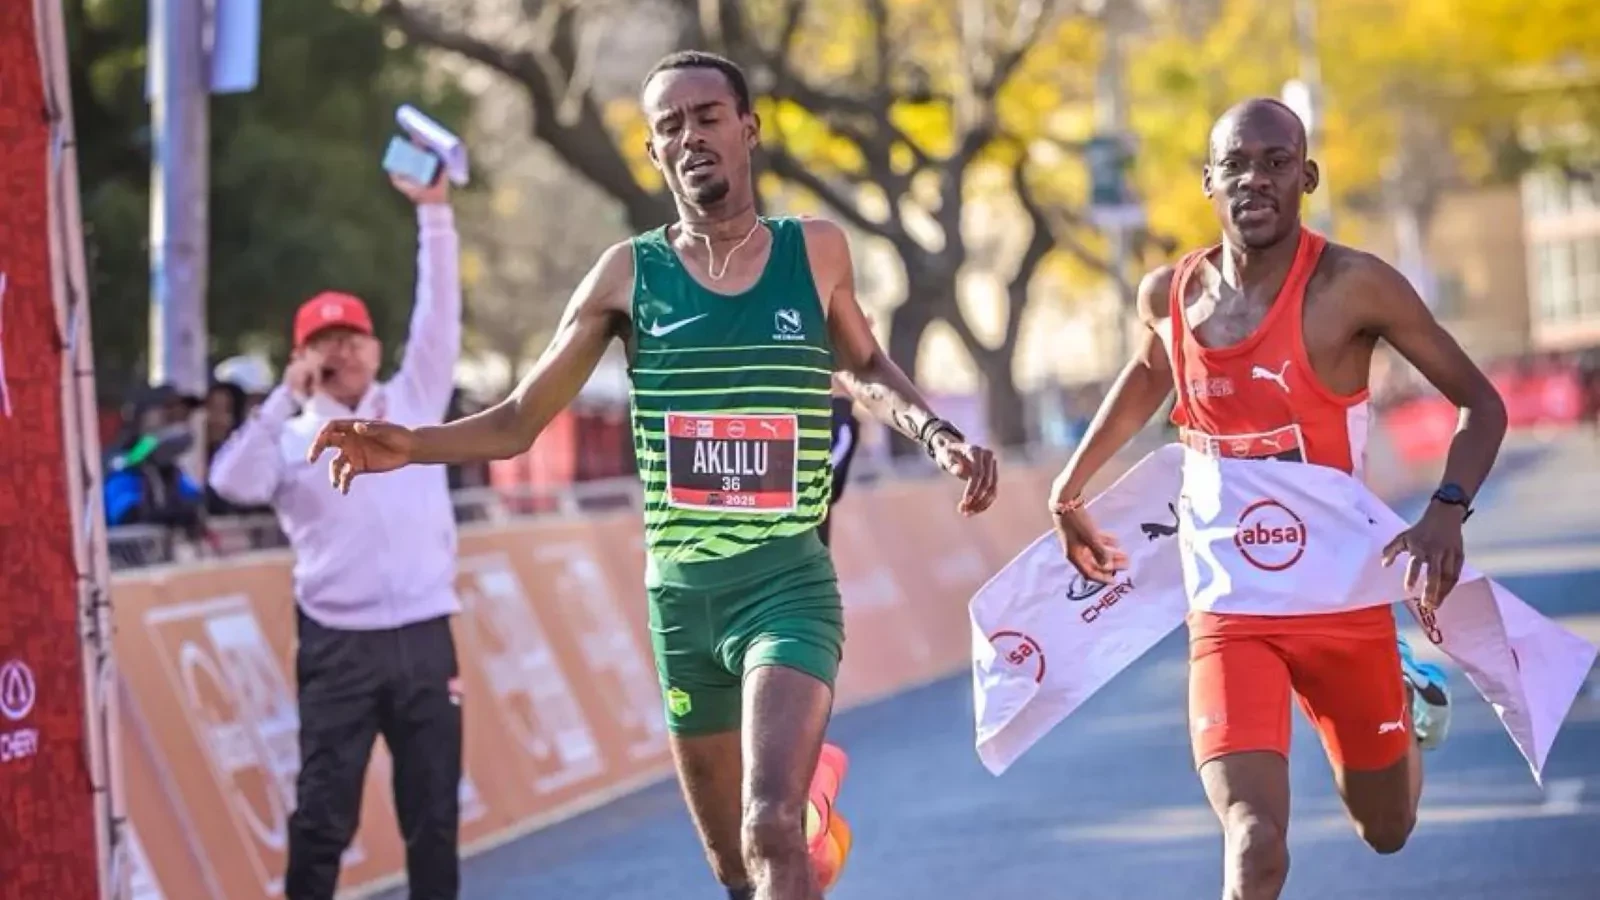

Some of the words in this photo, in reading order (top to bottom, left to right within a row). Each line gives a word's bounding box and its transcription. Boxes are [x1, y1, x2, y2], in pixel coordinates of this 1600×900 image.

[692, 440, 769, 476] AKLILU
[721, 476, 741, 491] 36
[1243, 522, 1298, 545] absa
[1081, 577, 1136, 624] CHERY
